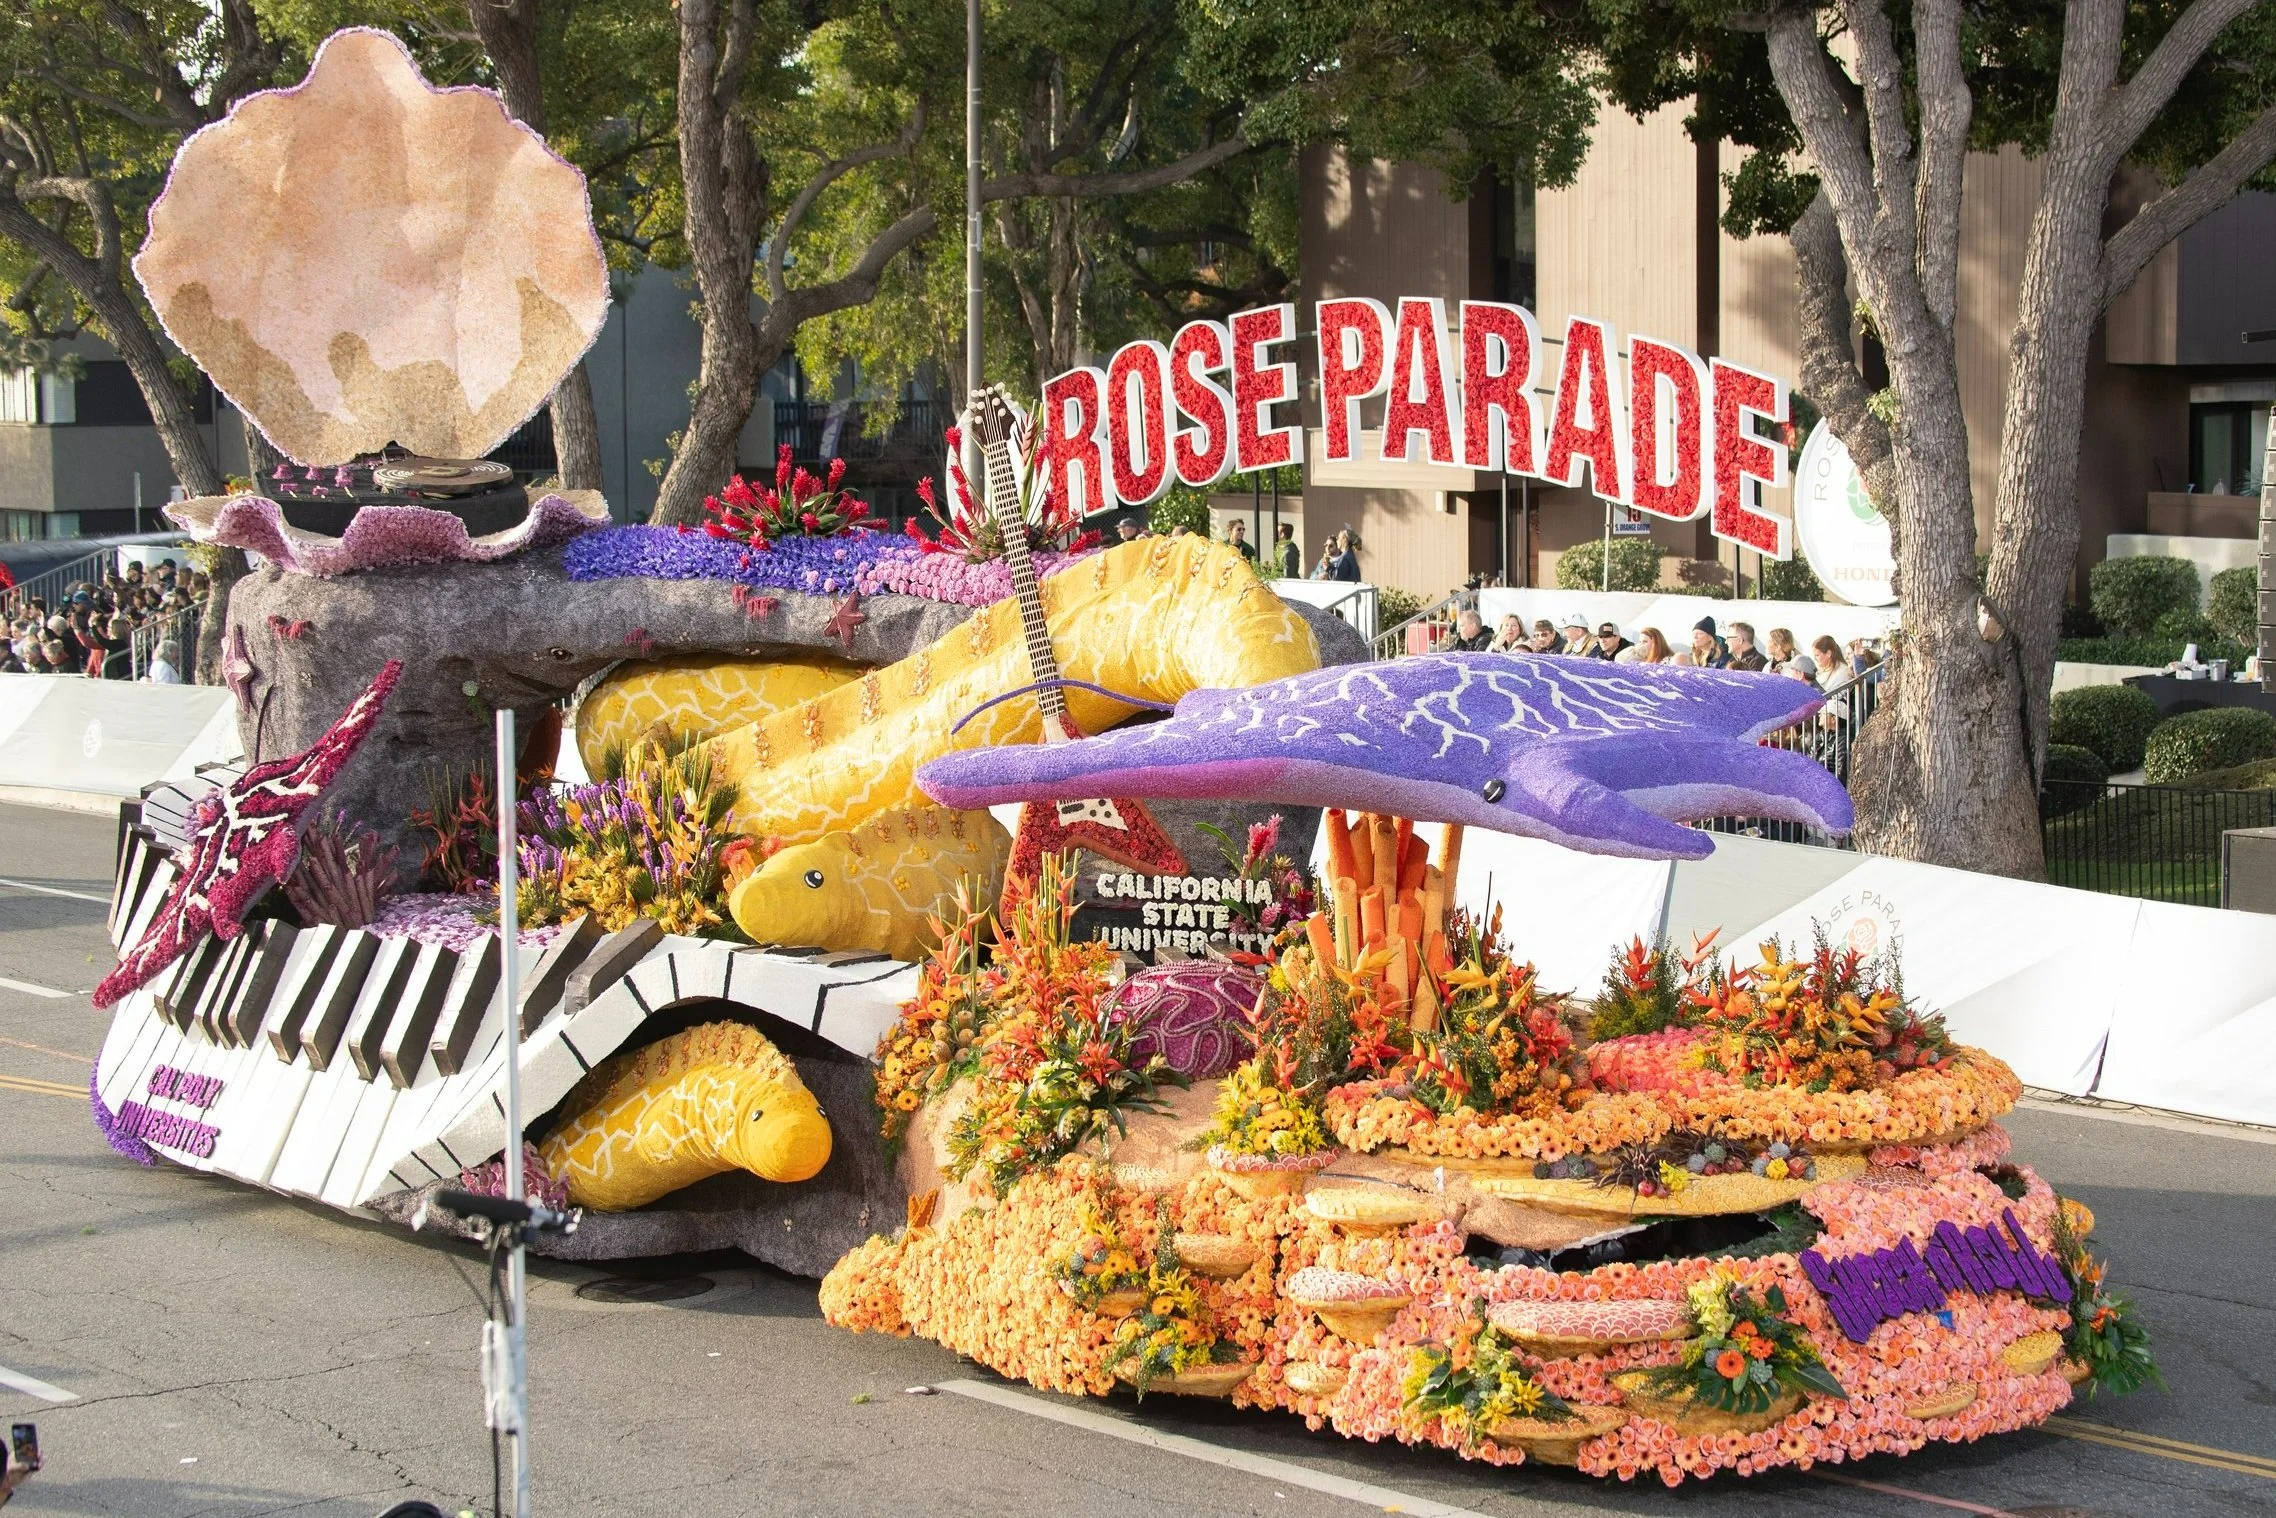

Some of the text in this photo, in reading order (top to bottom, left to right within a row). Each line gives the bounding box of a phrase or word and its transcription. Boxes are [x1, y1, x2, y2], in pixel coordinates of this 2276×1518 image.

[1042, 296, 1793, 561] ROSE PARADE
[1814, 435, 1841, 502] ROS
[1620, 523, 1637, 531] ORANGE
[1096, 874, 1273, 905] CALIFORNIA
[1142, 902, 1230, 930] STATE
[1822, 890, 1904, 949] OSE PARAD
[147, 1064, 224, 1110] CAL POLY
[112, 1100, 220, 1158] UNIVERSITIES
